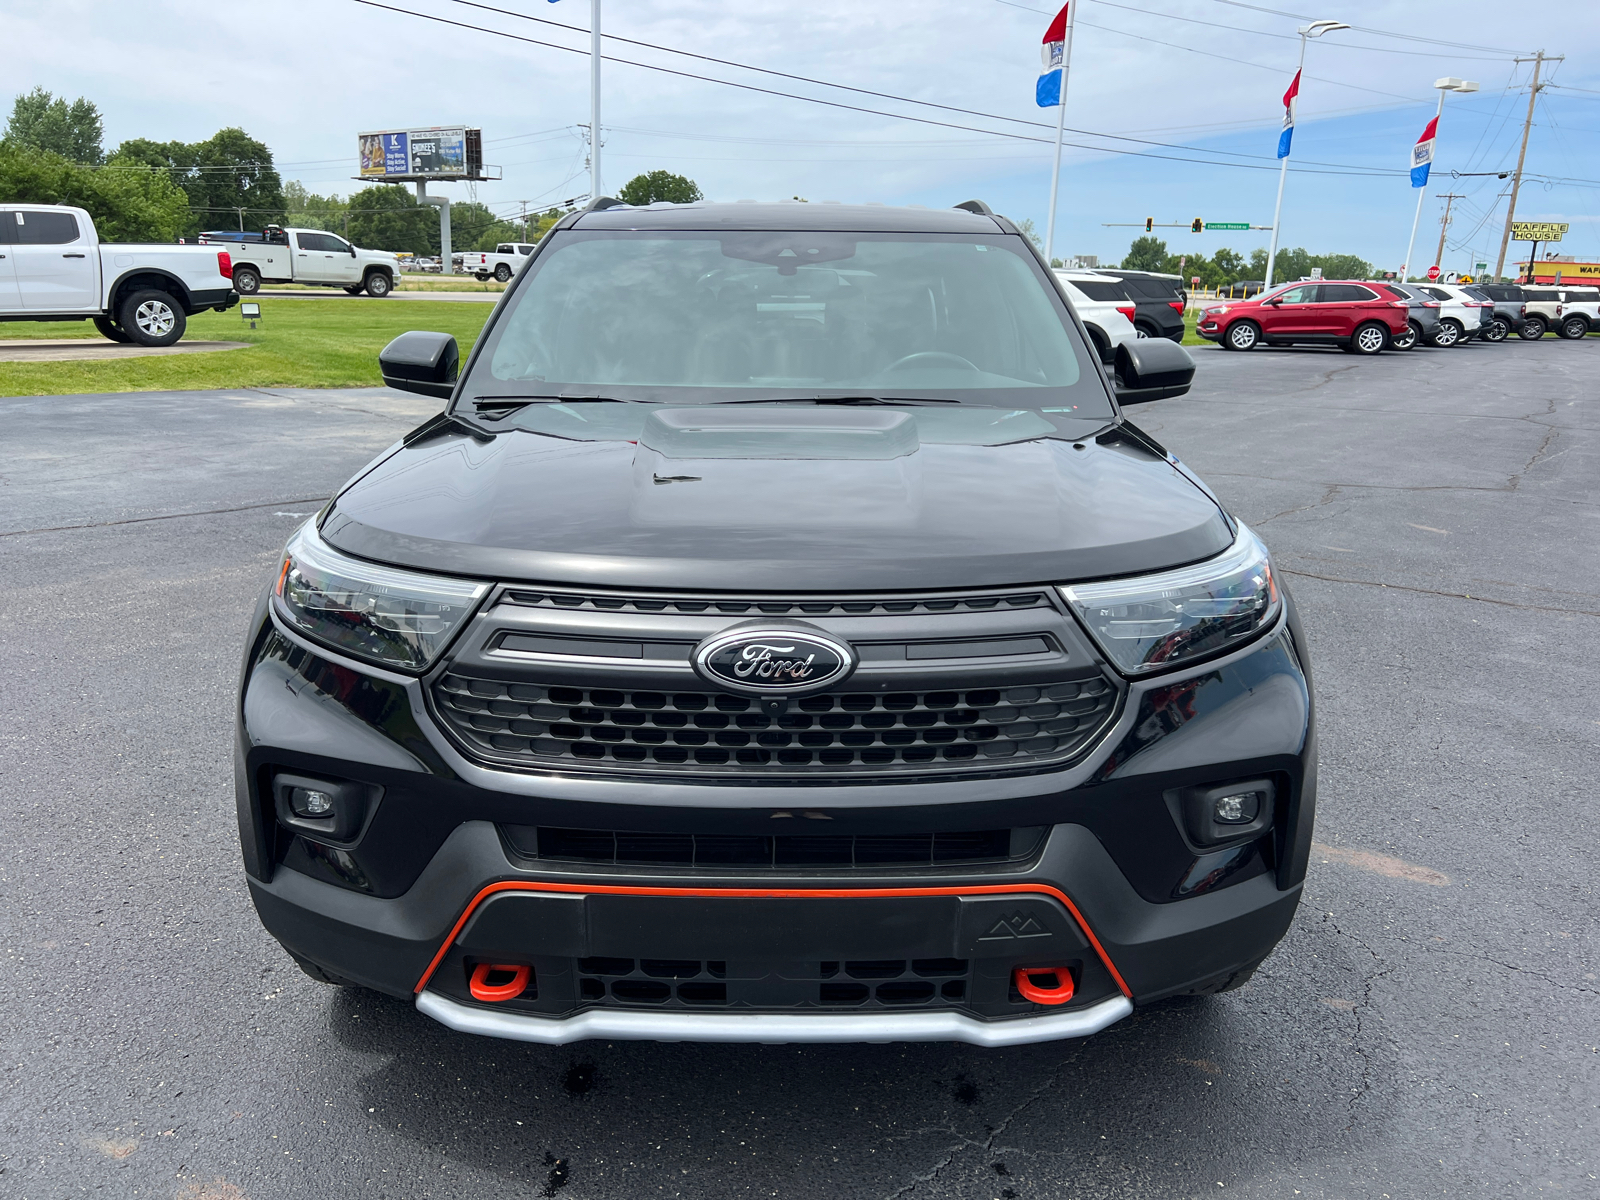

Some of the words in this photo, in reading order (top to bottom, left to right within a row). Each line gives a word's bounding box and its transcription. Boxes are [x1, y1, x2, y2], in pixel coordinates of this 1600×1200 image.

[391, 134, 398, 146] K
[1513, 223, 1567, 232] WAFFLE
[733, 644, 815, 678] Ford
